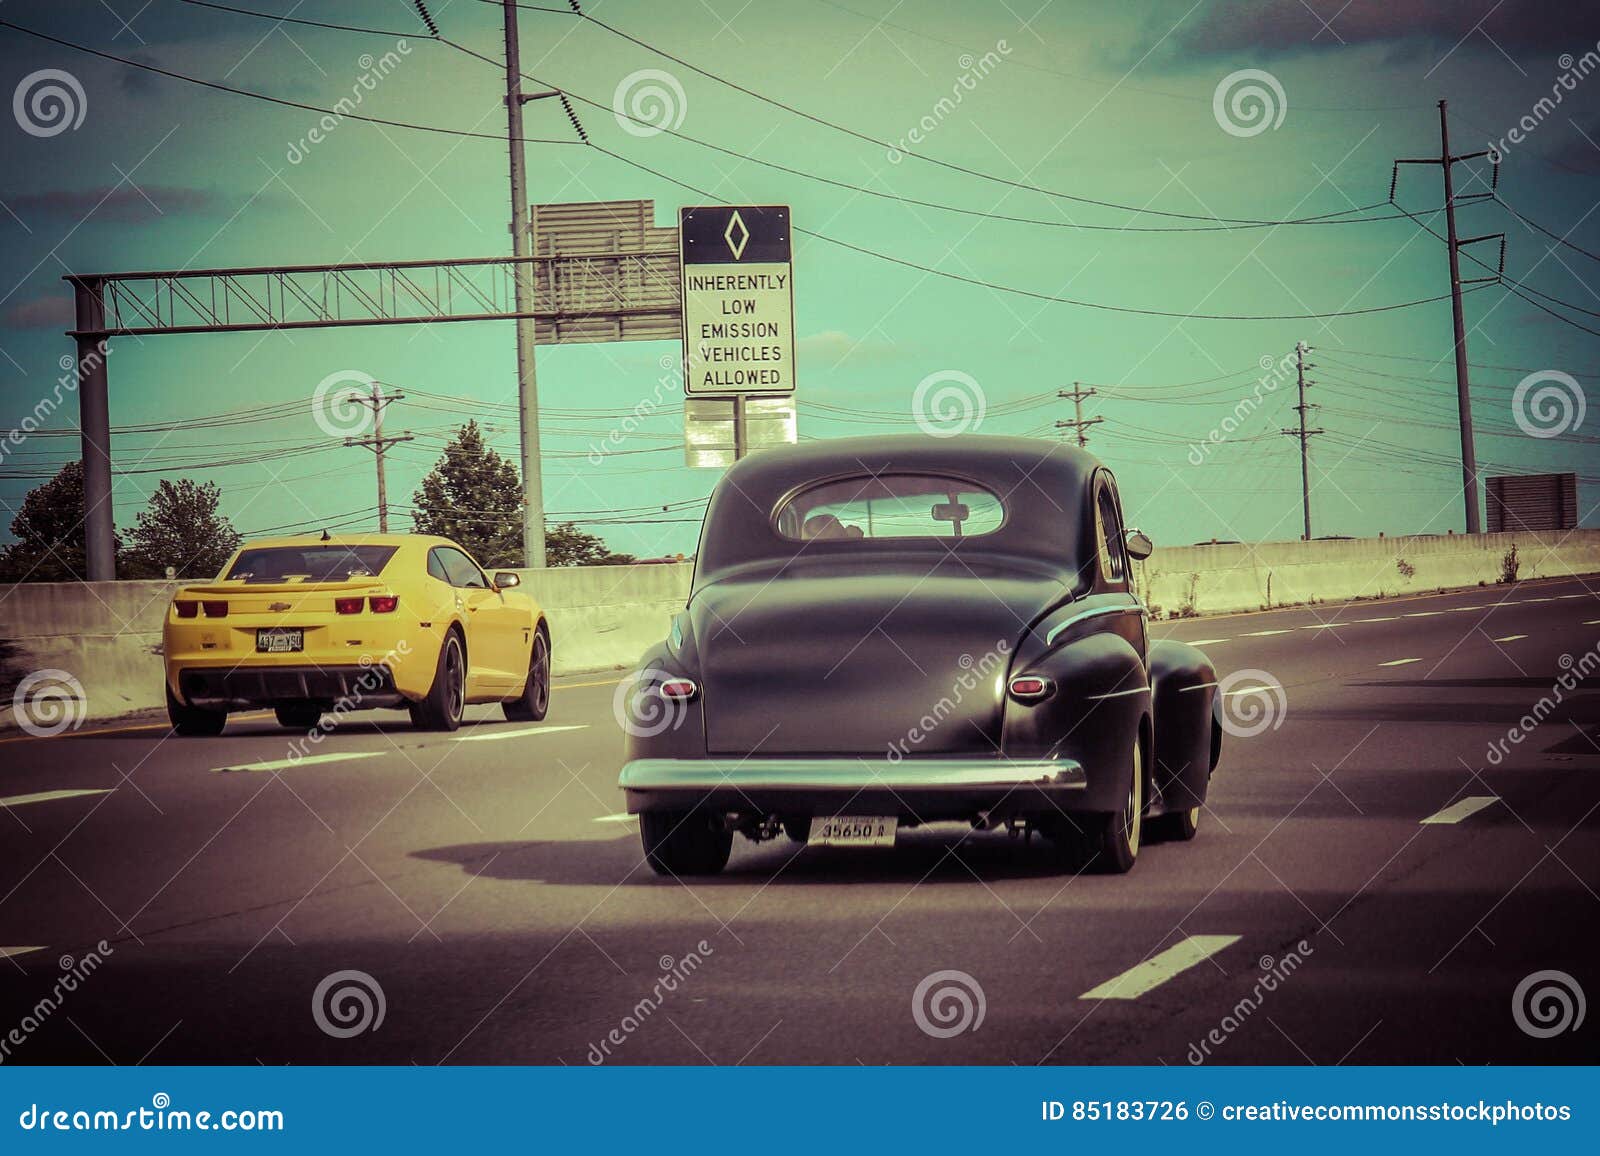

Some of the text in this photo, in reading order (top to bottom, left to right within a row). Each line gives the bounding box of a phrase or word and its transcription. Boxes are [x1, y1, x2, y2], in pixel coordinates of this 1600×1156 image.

[688, 274, 787, 291] INHERENTLY
[722, 299, 756, 315] LOW
[701, 322, 779, 339] EMISSION
[701, 346, 782, 362] VEHICLES
[703, 369, 781, 386] ALLOWED
